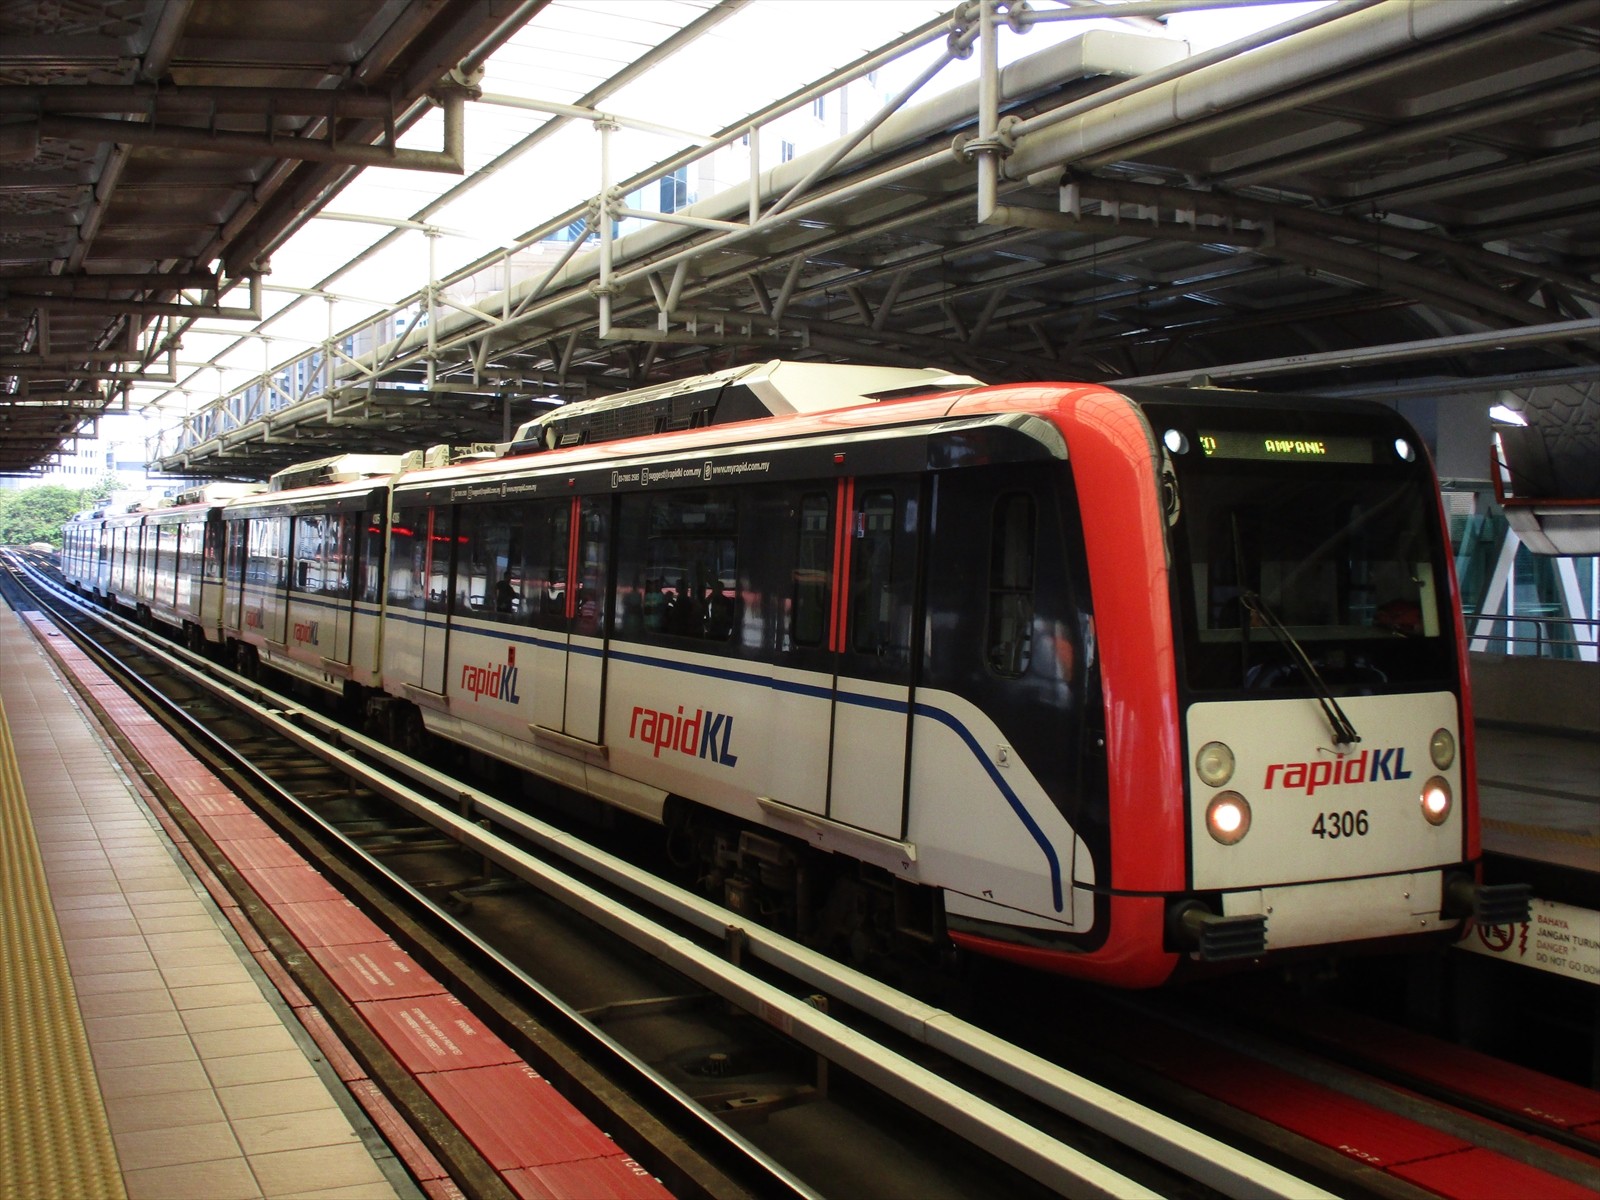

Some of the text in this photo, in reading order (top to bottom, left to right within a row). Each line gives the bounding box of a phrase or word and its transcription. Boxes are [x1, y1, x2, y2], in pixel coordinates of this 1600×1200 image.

[712, 461, 770, 475] www.myrapid.com.my
[461, 662, 520, 705] rapidKL
[629, 705, 738, 768] rapidKL
[1264, 747, 1412, 795] rapidKL
[1312, 809, 1369, 839] 4306
[1537, 915, 1568, 929] BAHAYA
[1537, 928, 1570, 942] JANGAN
[1536, 940, 1568, 955] DANGER
[1536, 952, 1548, 963] DO
[1550, 956, 1566, 967] NOT
[1568, 960, 1581, 971] GO
